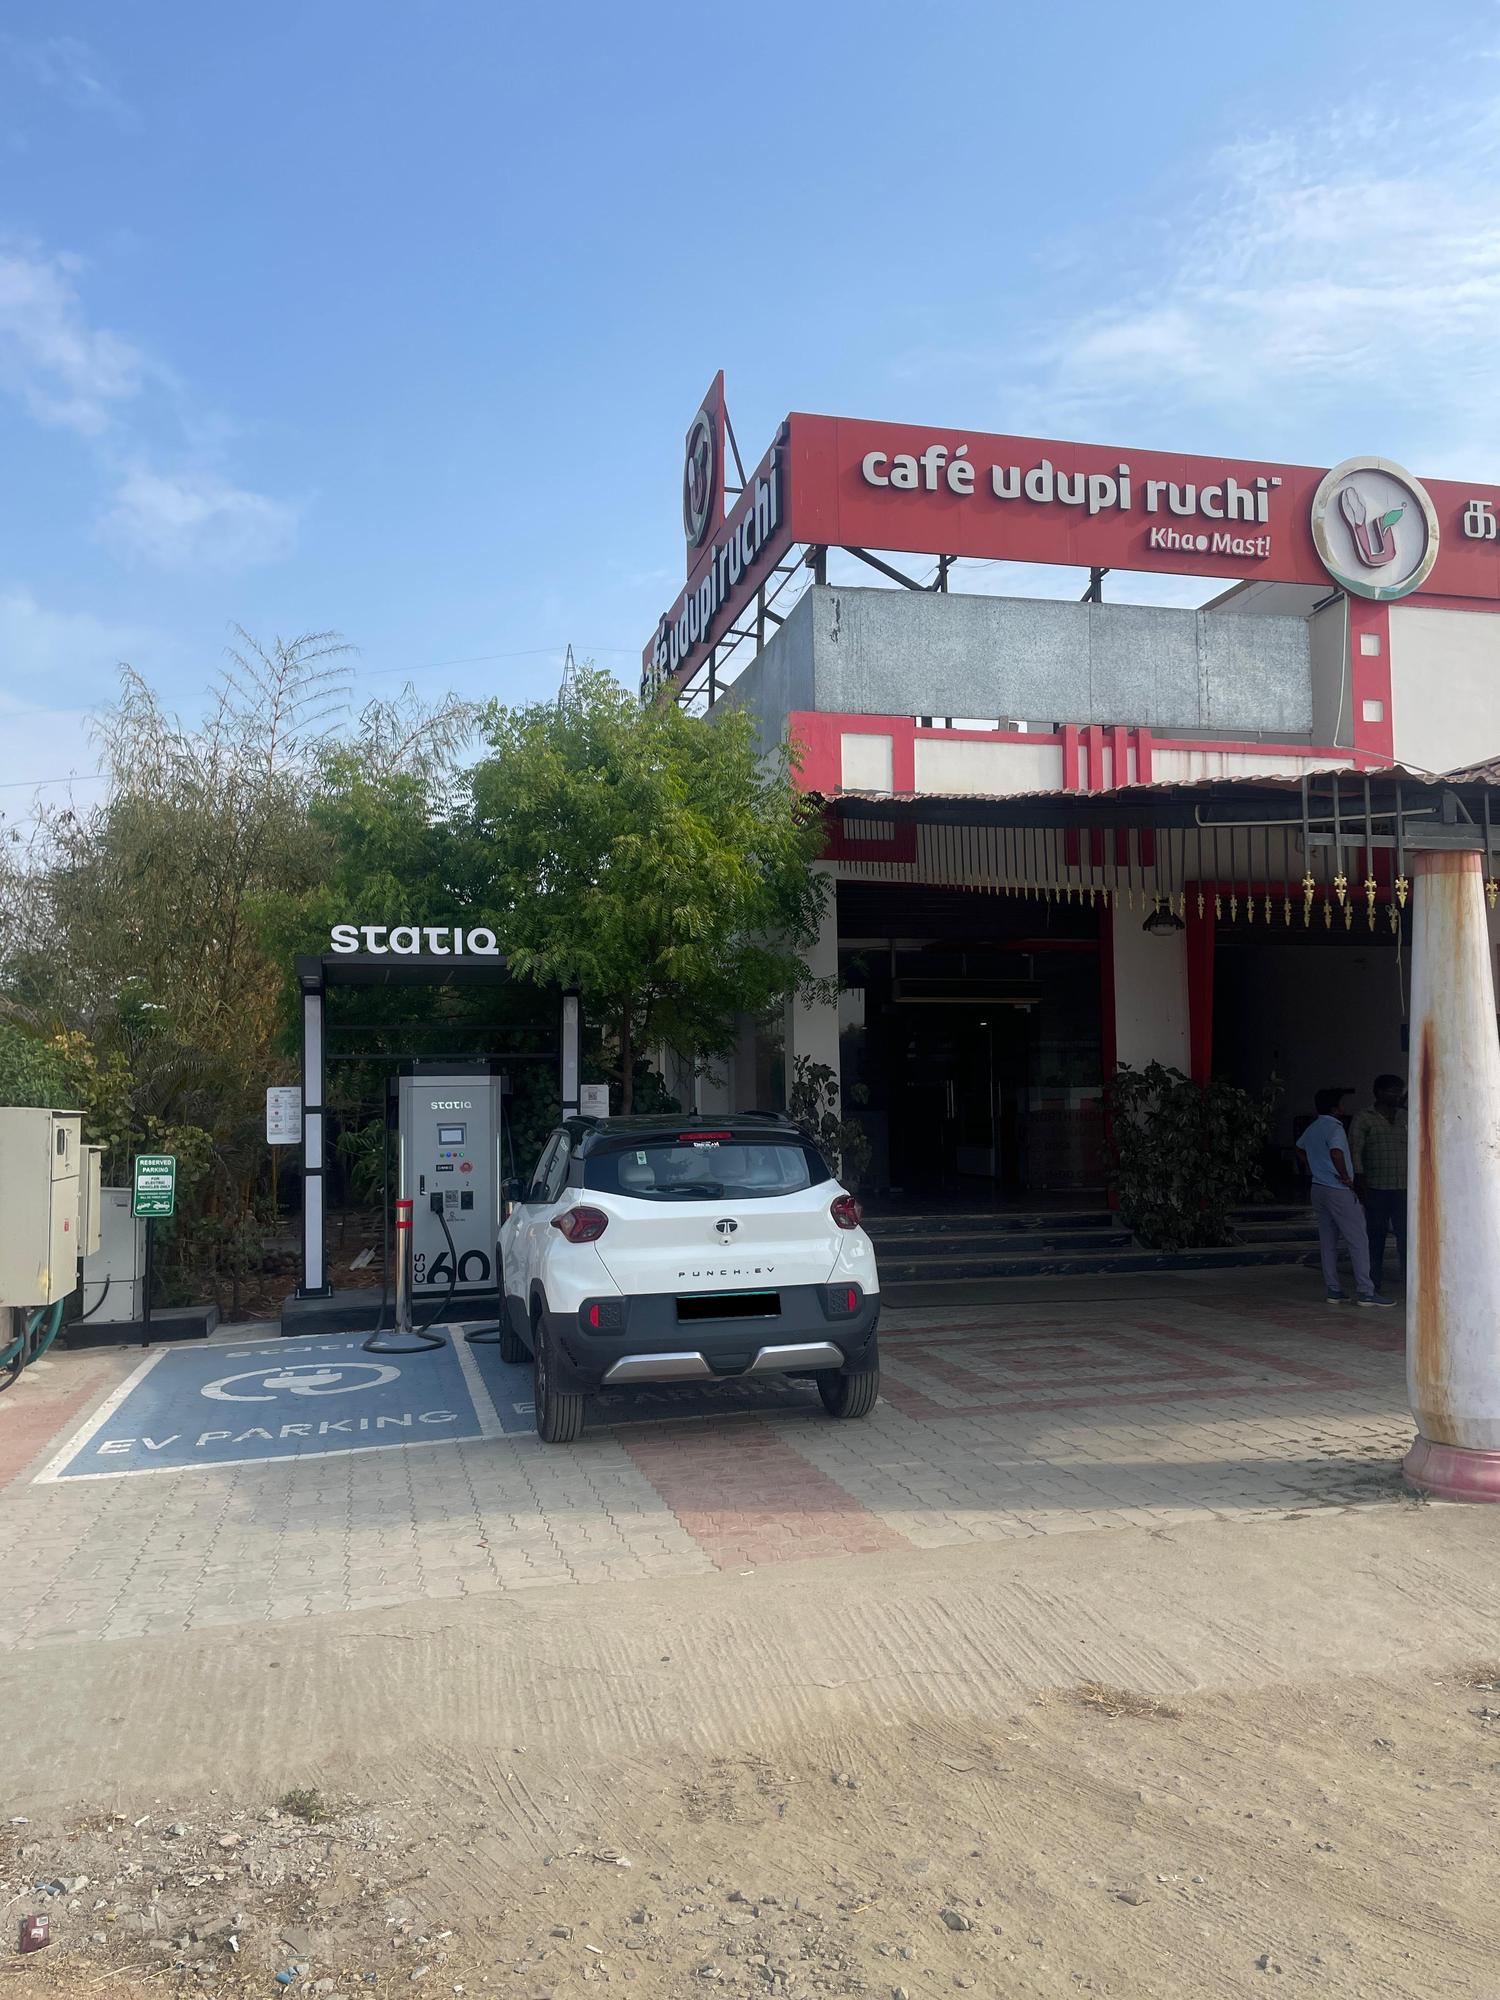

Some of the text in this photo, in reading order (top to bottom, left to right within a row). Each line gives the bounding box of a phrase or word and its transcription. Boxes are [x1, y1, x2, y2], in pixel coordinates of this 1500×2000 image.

[862, 444, 976, 495] café
[992, 459, 1131, 515] udupi
[1147, 477, 1269, 523] ruchi
[669, 545, 718, 671] udupi
[716, 448, 778, 599] ruchi
[1151, 527, 1271, 556] Khao Mast!
[414, 1253, 425, 1283] CCS
[427, 1250, 490, 1284] 60
[96, 1410, 459, 1454] EV PARKING
